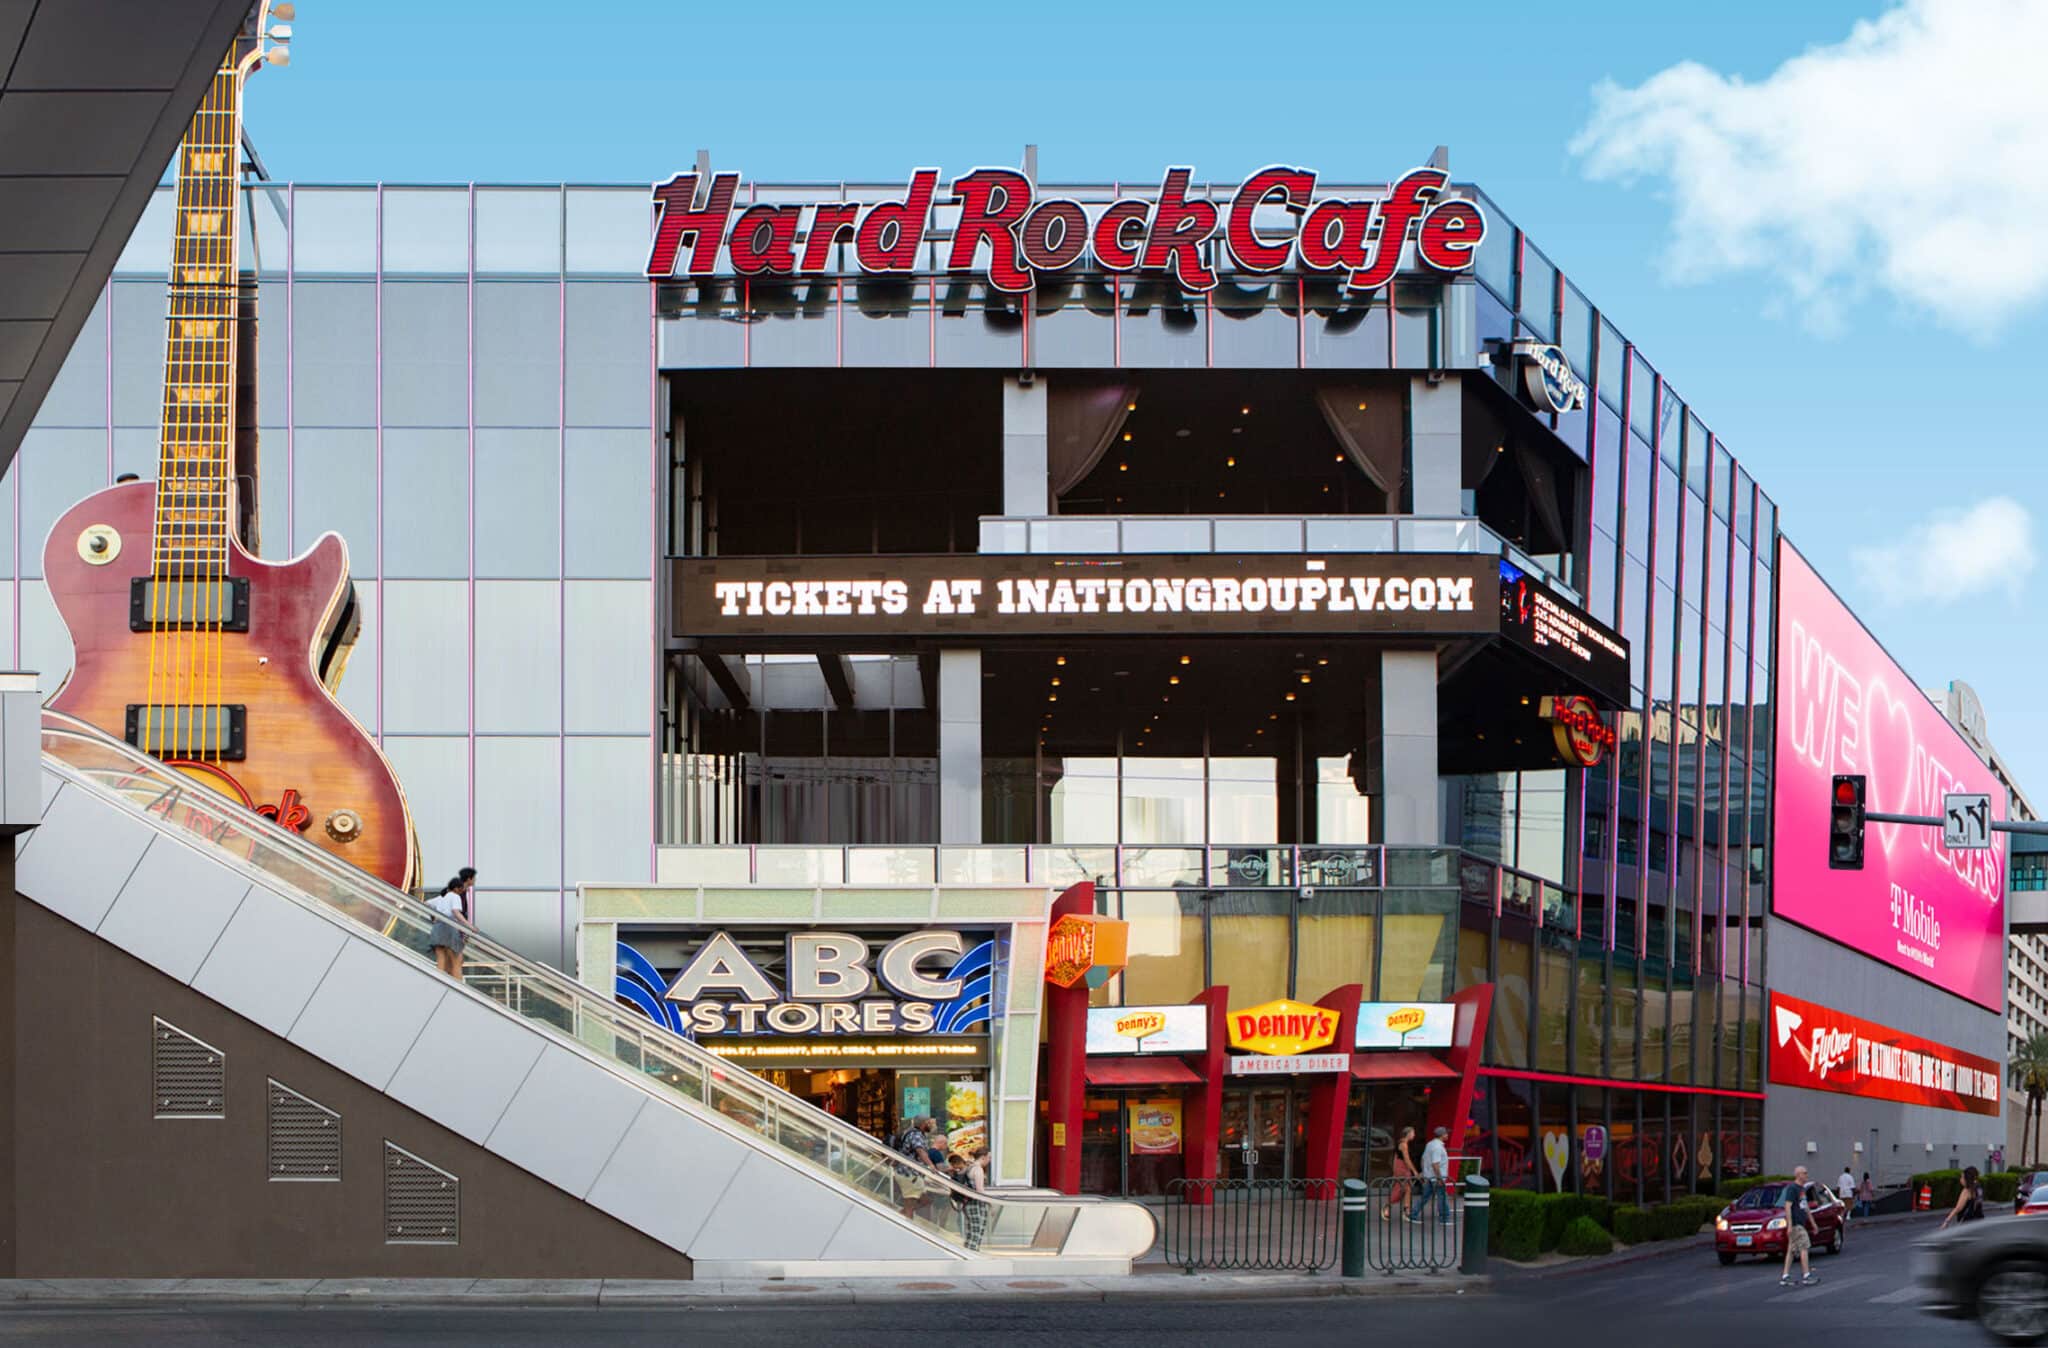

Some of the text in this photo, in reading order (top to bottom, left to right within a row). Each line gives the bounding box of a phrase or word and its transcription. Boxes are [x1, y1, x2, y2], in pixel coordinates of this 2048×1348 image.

[645, 163, 1488, 291] Hard Rock Cafe
[714, 576, 1475, 616] TICKETS AT 1NATIONGROUPLV.COM
[1791, 620, 1864, 778] WE
[1946, 834, 1968, 846] ONLY
[1902, 889, 1941, 951] Mobile
[661, 929, 966, 1002] ABC
[1046, 926, 1091, 966] enny's
[690, 1001, 937, 1034] STORES
[1116, 1015, 1159, 1033] Denny's
[1237, 1010, 1333, 1042] Denny's
[1387, 1012, 1420, 1026] Denny's
[1238, 1056, 1344, 1072] AMERICA'S DINER
[1809, 1027, 1852, 1080] FlyOver
[1857, 1037, 1870, 1075] THE
